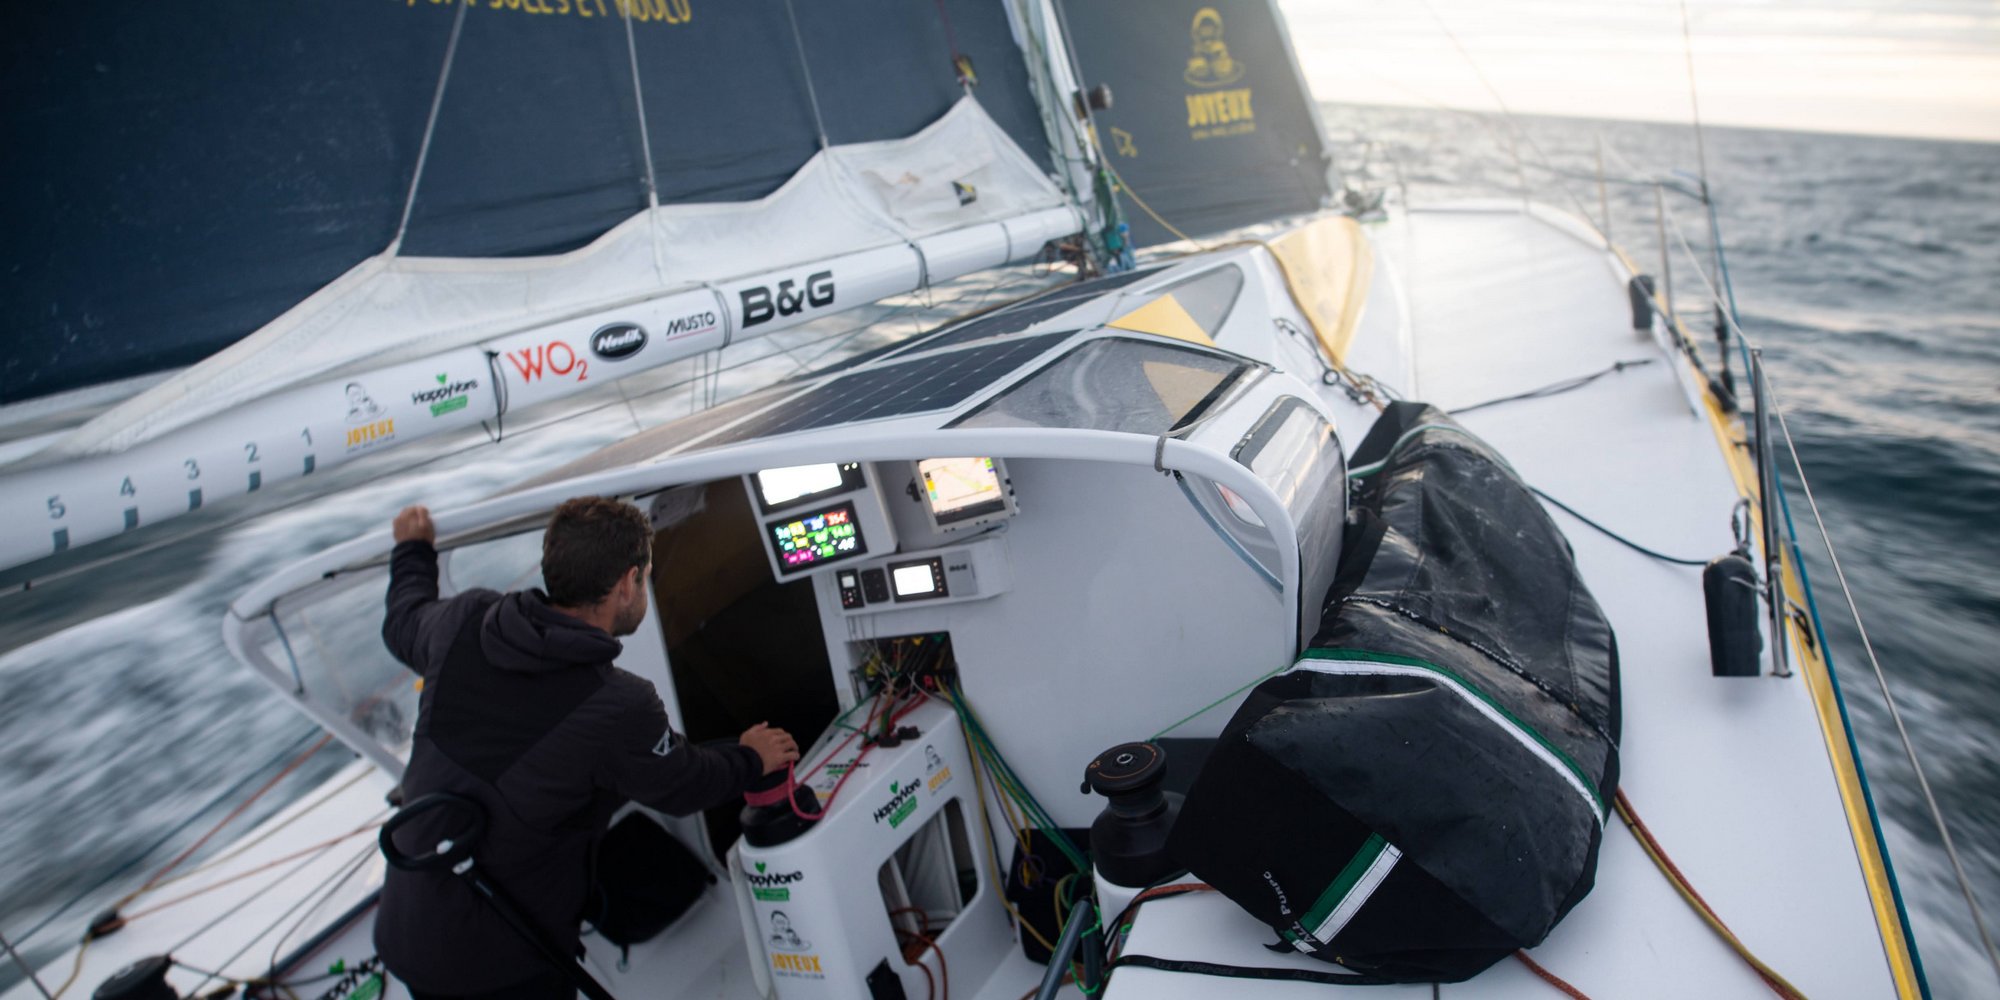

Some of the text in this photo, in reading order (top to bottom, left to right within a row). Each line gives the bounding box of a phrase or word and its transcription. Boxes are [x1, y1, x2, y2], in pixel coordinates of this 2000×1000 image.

[739, 269, 836, 330] B&G
[665, 310, 716, 336] MUSTO
[301, 426, 315, 447] 1
[346, 417, 395, 447] JOYEUX
[244, 442, 261, 463] 2
[184, 458, 201, 480] 3
[119, 475, 137, 498] 4
[47, 495, 66, 519] 5
[873, 777, 922, 824] HappyVore
[771, 952, 822, 973] JOYEUX
